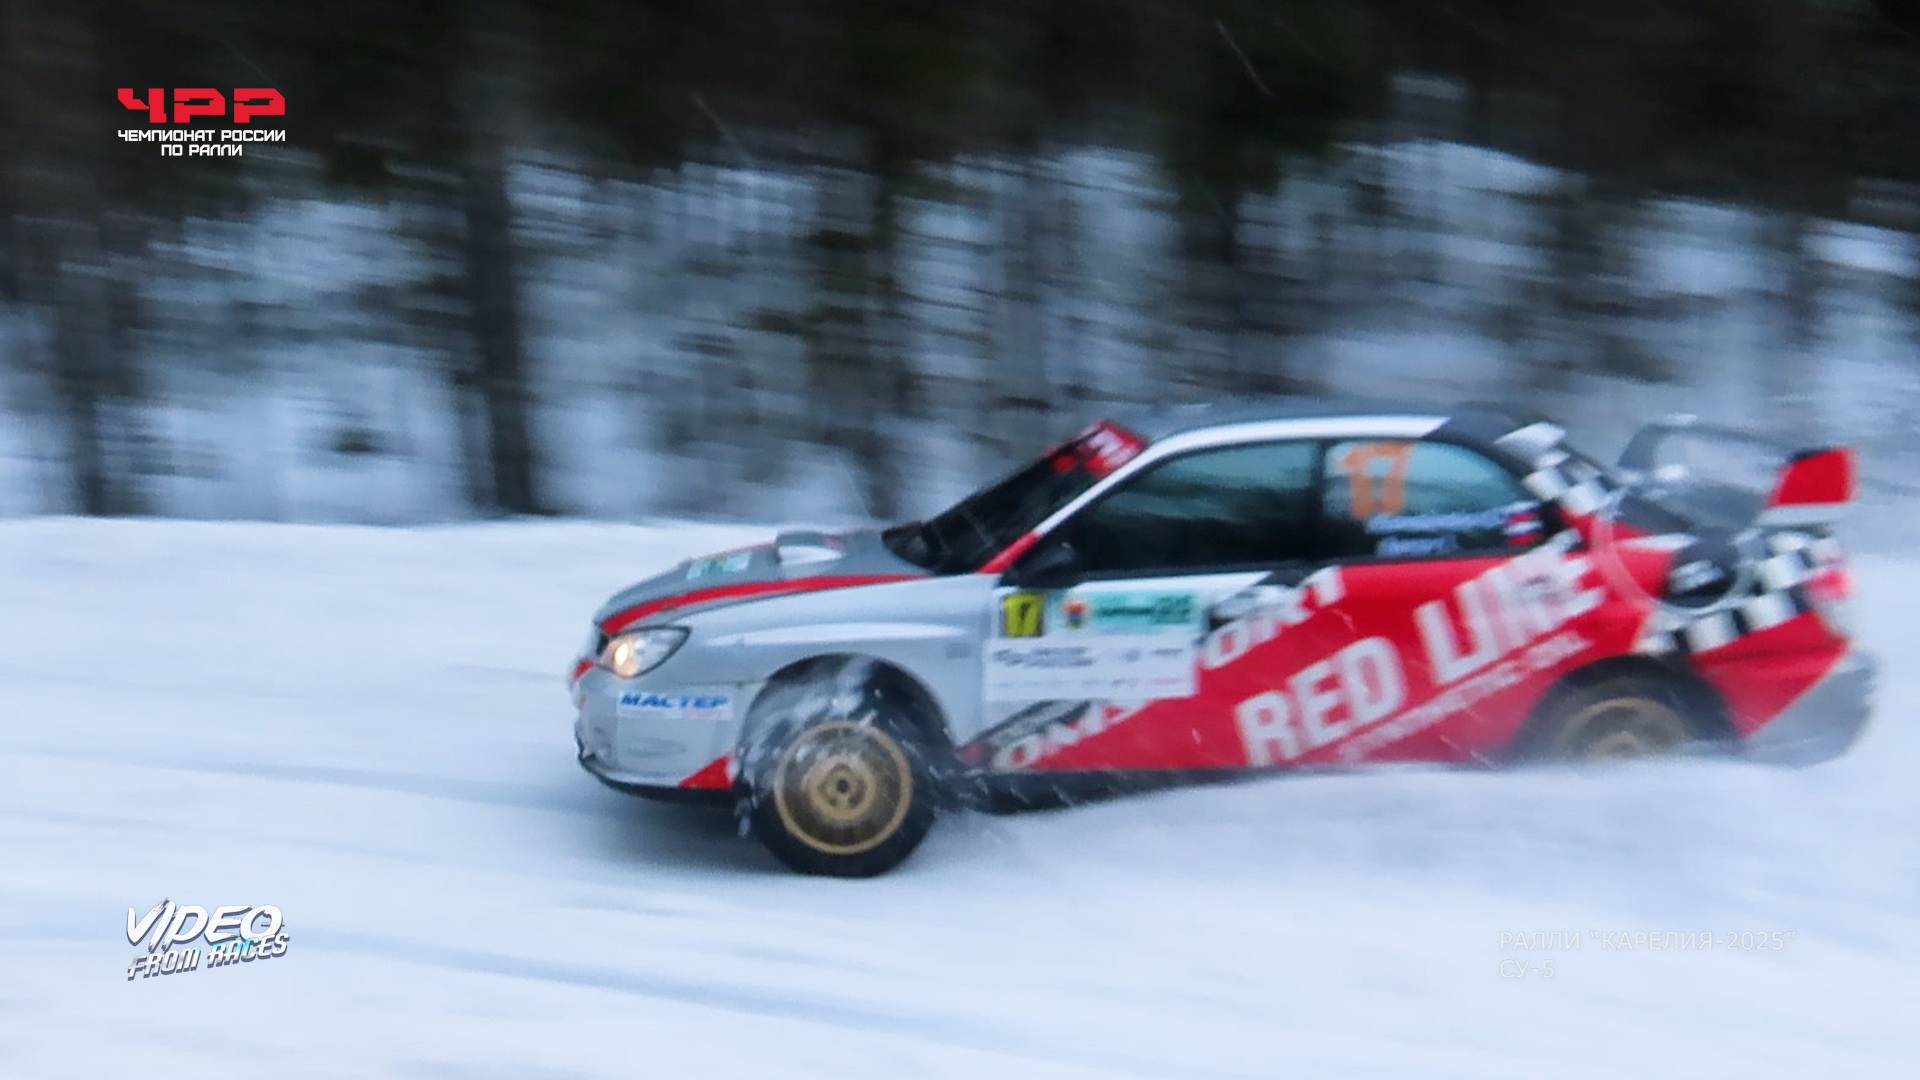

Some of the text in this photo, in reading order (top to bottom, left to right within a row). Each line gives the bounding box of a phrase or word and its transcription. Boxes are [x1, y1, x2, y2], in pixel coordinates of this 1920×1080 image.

[1337, 441, 1419, 520] 17
[1002, 593, 1044, 638] 17
[1235, 636, 1408, 769] RED
